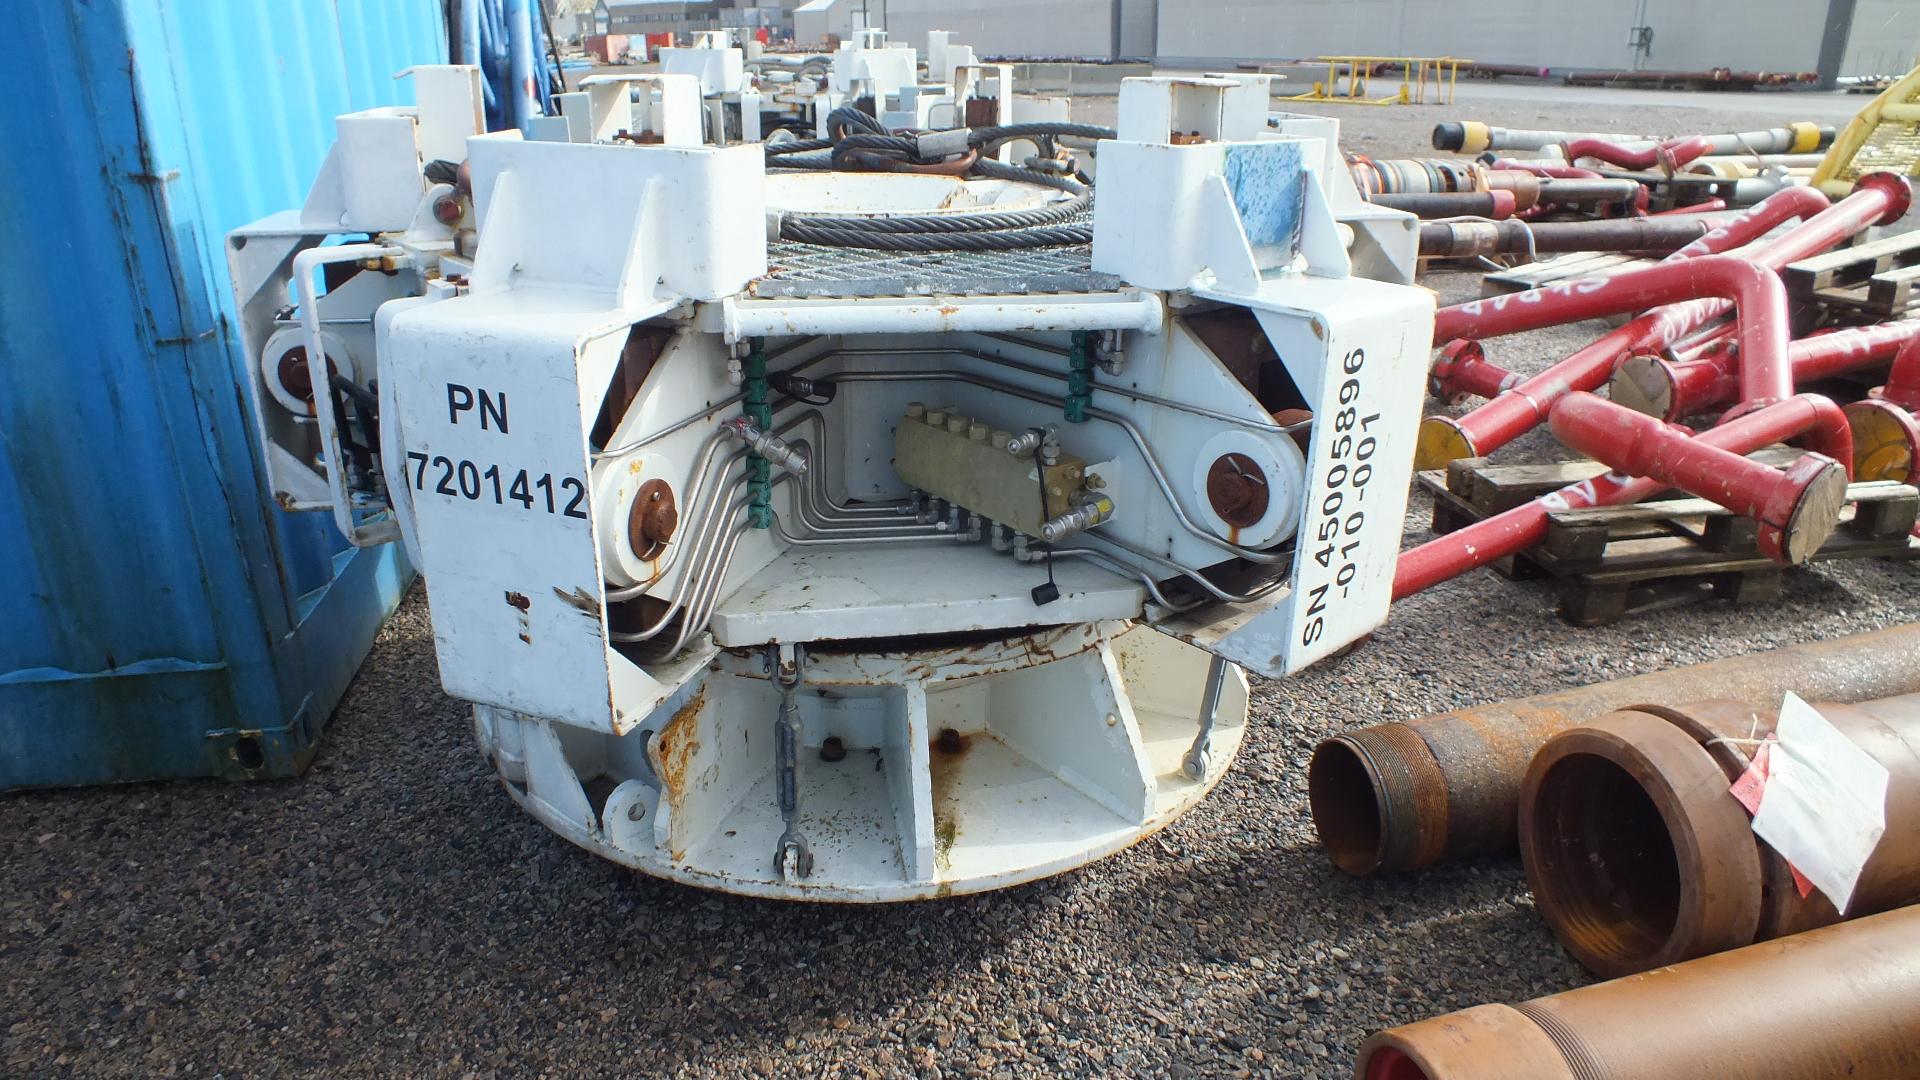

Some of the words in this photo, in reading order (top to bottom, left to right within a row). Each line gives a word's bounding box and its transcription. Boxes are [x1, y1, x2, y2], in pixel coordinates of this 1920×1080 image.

[447, 383, 508, 434] PN
[407, 451, 587, 519] 7201412
[1315, 348, 1364, 568] 45005896
[1303, 583, 1329, 646] SN
